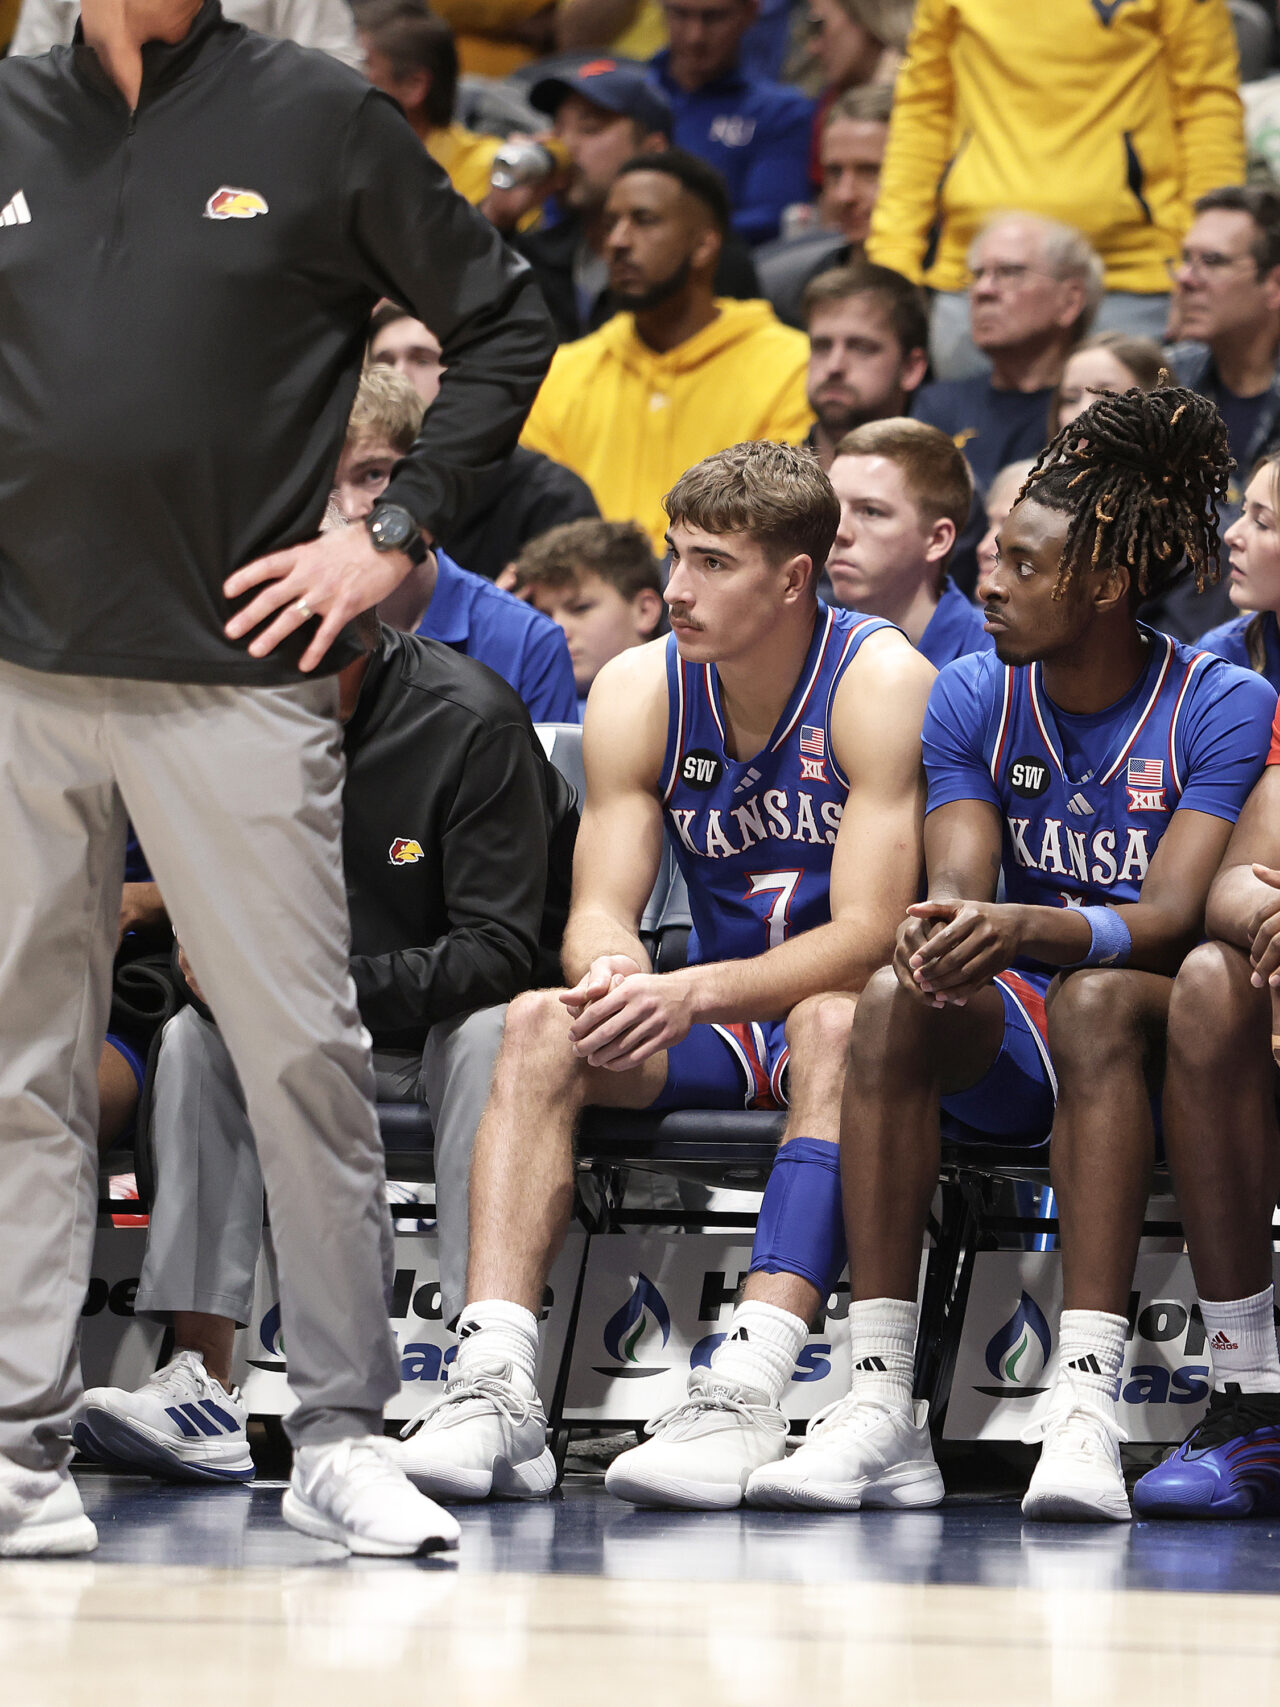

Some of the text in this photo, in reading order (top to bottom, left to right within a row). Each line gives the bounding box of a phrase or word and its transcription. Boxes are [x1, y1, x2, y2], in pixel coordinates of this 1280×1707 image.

[684, 757, 717, 782] SW
[801, 757, 827, 781] XII
[1012, 763, 1044, 790] SW
[1127, 788, 1167, 811] XII
[669, 789, 843, 858] KANSAS
[1008, 817, 1149, 885] KANSA
[743, 868, 804, 949] 7
[1210, 1340, 1239, 1351] adidas
[1112, 1363, 1209, 1405] as
